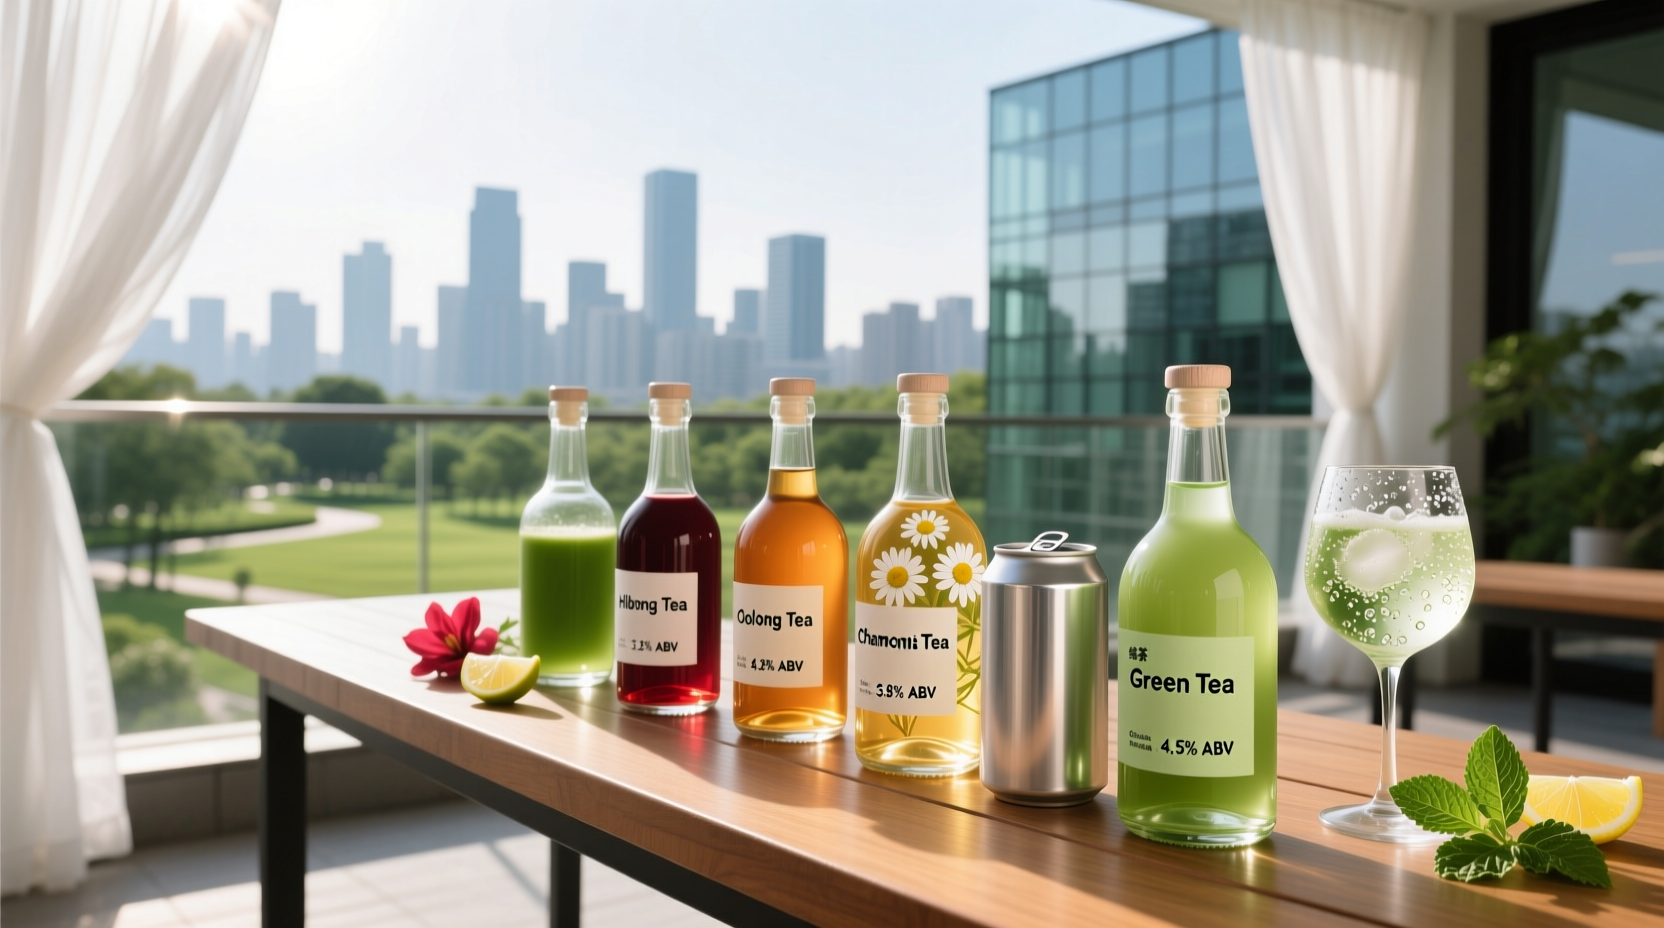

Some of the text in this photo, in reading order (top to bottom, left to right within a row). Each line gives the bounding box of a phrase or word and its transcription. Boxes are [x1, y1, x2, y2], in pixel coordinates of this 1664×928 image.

[661, 596, 687, 612] Tea
[736, 608, 813, 631] Oolong Tea
[655, 641, 678, 652] ABV
[920, 633, 949, 650] Tea
[777, 660, 804, 672] ABV
[1130, 667, 1235, 694] Green Tea
[907, 686, 937, 699] ABV
[1160, 738, 1198, 756] 4.5%
[1201, 740, 1234, 756] ABV
